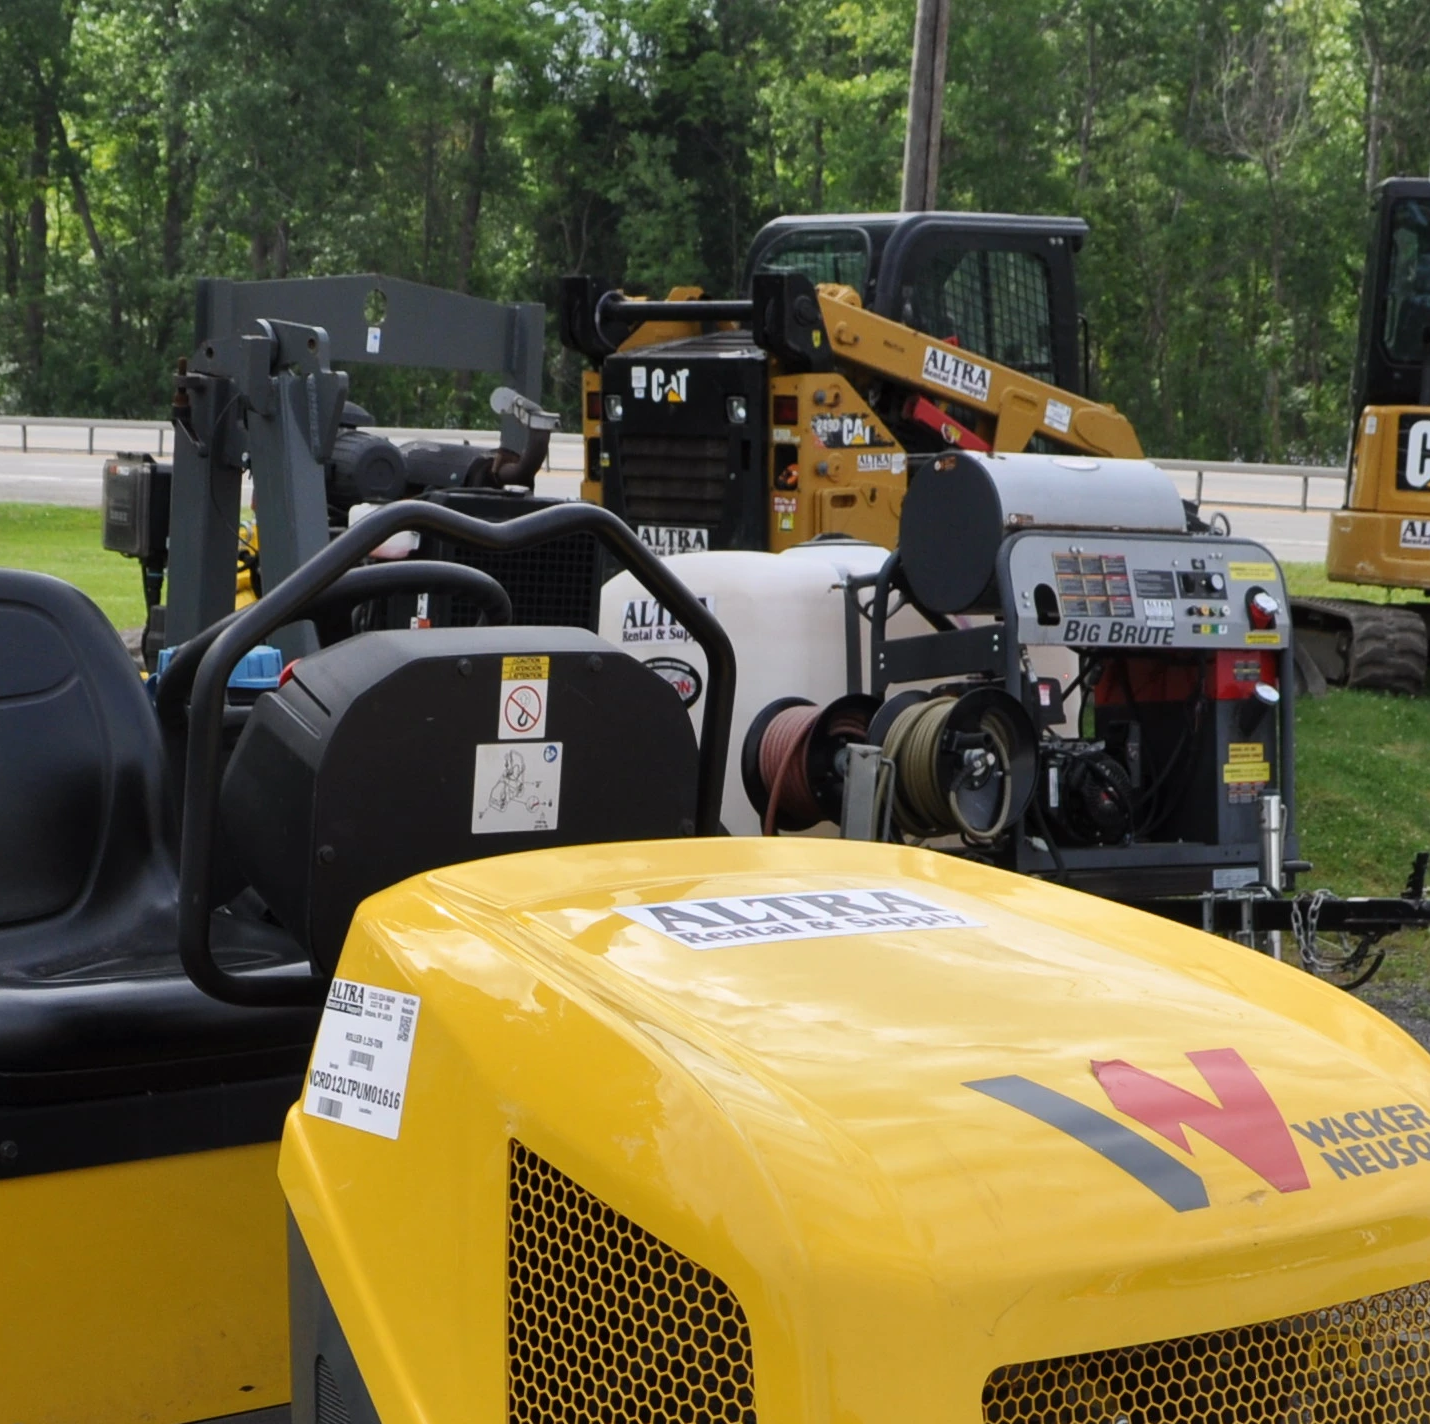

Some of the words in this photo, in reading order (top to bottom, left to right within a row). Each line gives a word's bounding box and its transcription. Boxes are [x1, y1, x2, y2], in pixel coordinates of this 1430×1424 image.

[926, 350, 987, 388] ALTRA
[652, 368, 689, 402] CAT
[641, 528, 706, 549] ALTRA
[623, 628, 653, 642] Rental
[656, 628, 665, 640] &
[1063, 620, 1102, 643] BIG
[1108, 621, 1175, 645] BRUTE
[646, 891, 948, 932] ALTRA
[676, 920, 802, 945] Rental
[807, 917, 842, 931] &
[845, 909, 968, 929] Supply
[330, 980, 365, 1005] ALTRA
